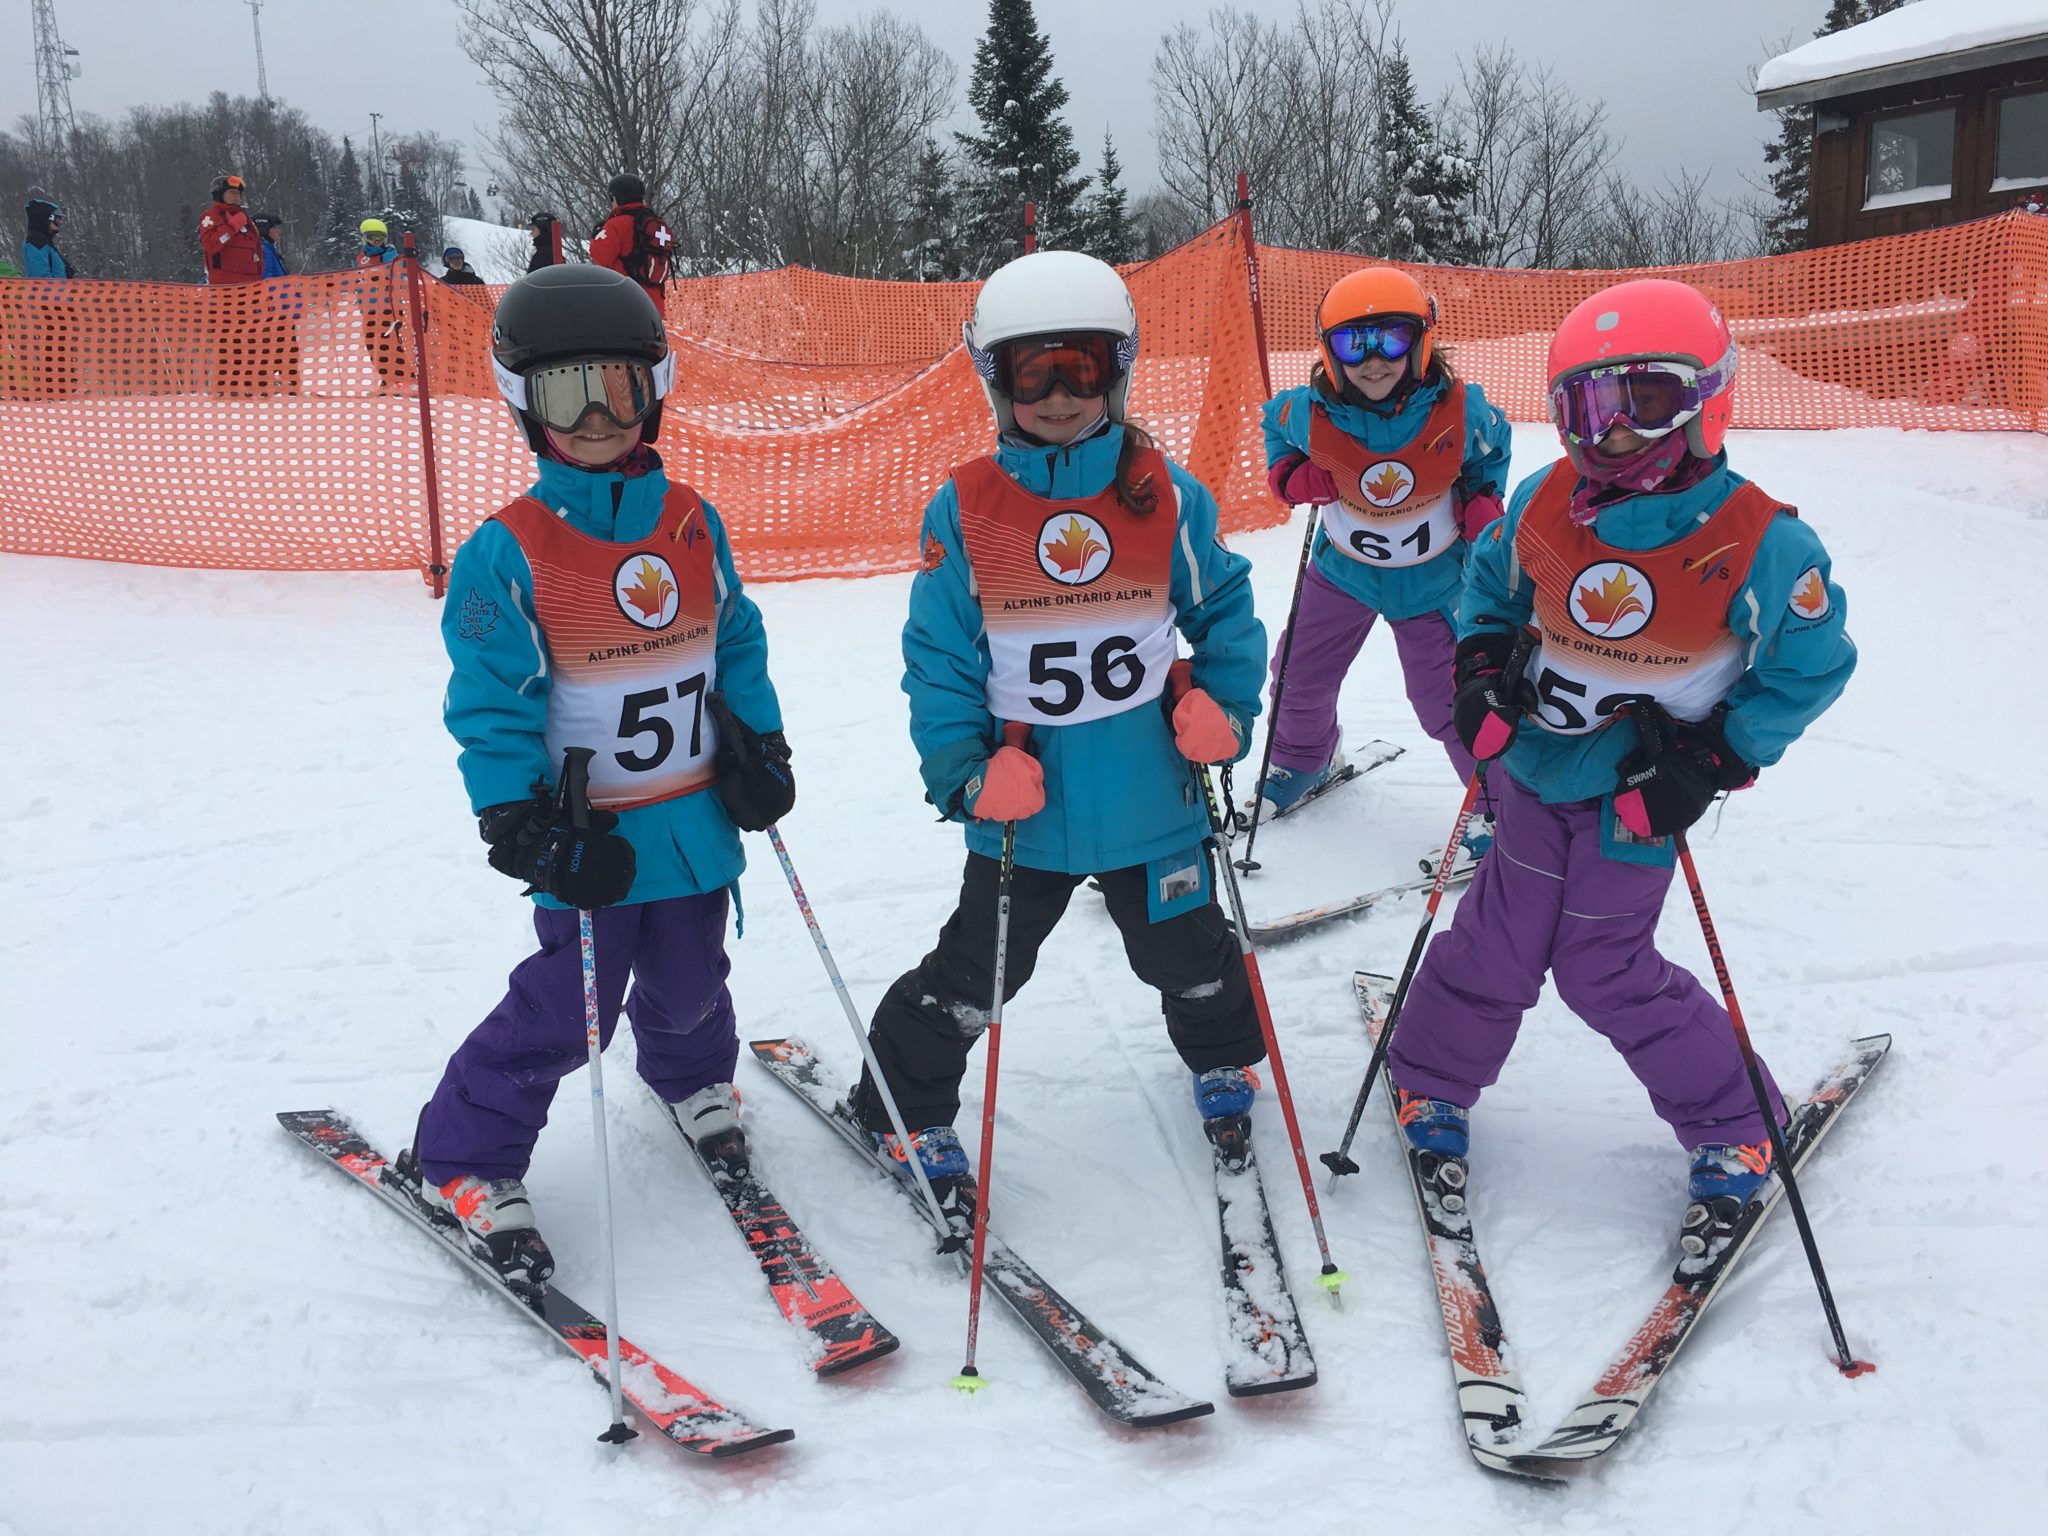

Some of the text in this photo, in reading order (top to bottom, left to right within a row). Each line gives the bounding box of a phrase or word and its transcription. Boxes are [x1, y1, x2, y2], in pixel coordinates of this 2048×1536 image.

[1370, 506, 1413, 518] ONTARIO
[1350, 521, 1430, 560] 61
[1003, 589, 1152, 611] ALPINE ONTARIO ALPIN
[588, 625, 709, 663] ALPINE ONTARIO ALPIN
[1574, 640, 1638, 663] ONTARIO
[1644, 655, 1689, 665] ALPIN
[1028, 635, 1146, 716] 56
[614, 671, 707, 772] 57
[1626, 764, 1657, 786] SWANY
[569, 840, 585, 873] KOMBI
[804, 1298, 855, 1321] ROSSIGN
[1433, 1255, 1469, 1357] SSIGNOL
